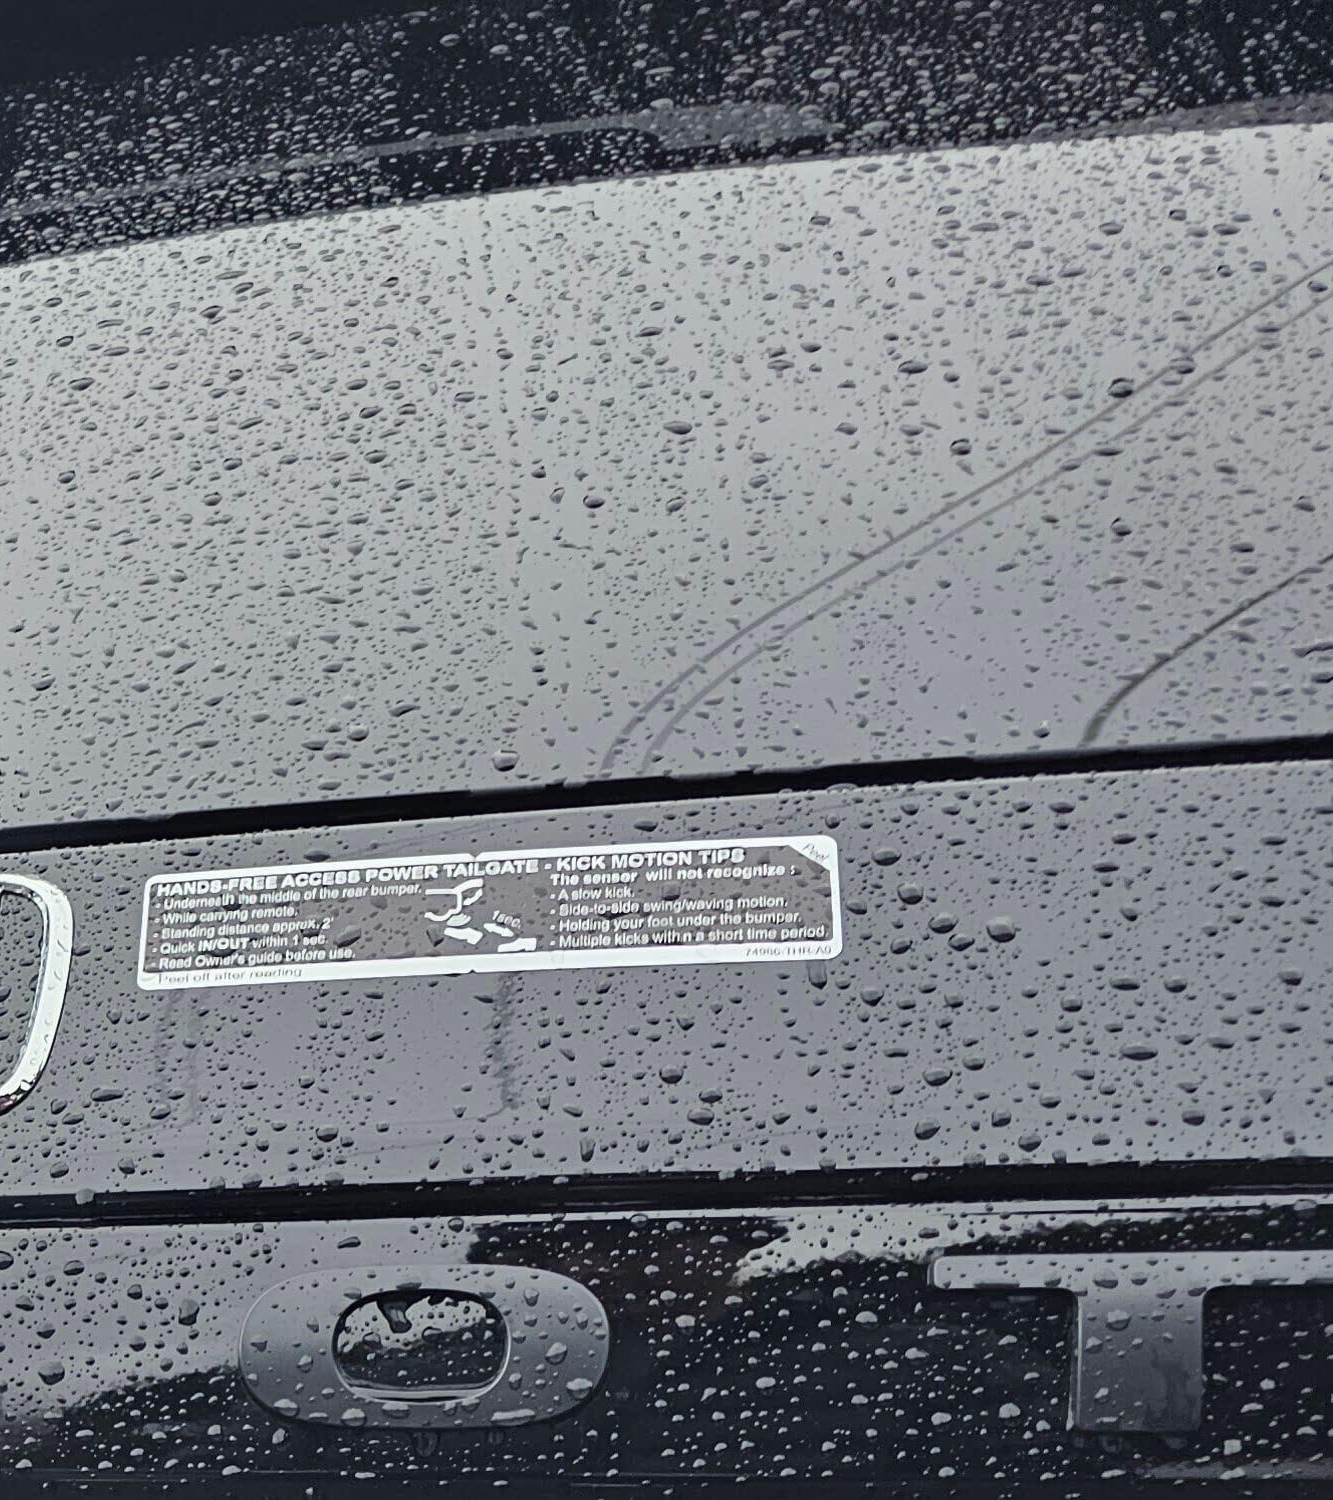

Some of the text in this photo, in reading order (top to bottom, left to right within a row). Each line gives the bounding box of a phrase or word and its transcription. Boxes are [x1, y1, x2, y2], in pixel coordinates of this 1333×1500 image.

[157, 877, 278, 896] HANDS-FREE
[281, 871, 360, 888] ACCESS
[365, 866, 438, 882] POWER
[443, 860, 539, 877] TAILGATE
[556, 856, 606, 871] KICK
[611, 852, 692, 869] MOTION
[698, 848, 745, 865] TIPS
[550, 873, 579, 886] The
[583, 871, 638, 885] sensor
[645, 867, 673, 882] will
[676, 867, 703, 881] not
[706, 863, 786, 880] recognize
[238, 893, 258, 905] the
[260, 890, 302, 904] middle
[304, 888, 317, 901] of
[319, 886, 339, 899] the
[341, 885, 368, 898] rear
[558, 889, 569, 901] A
[571, 887, 602, 900] slow
[643, 899, 733, 914] swing/waving
[163, 910, 198, 924] While
[559, 917, 611, 933] Holding
[613, 917, 645, 933] your
[647, 914, 674, 928] foot
[676, 913, 716, 928] under
[719, 912, 743, 925] the
[161, 924, 216, 940] Standing
[217, 922, 270, 936] distance
[559, 934, 612, 949] Multiple
[614, 932, 650, 946] kicks
[695, 931, 705, 943] a
[708, 928, 744, 943] short
[747, 927, 778, 941] time
[160, 940, 196, 955] Quick
[197, 937, 250, 952] IN/OUT
[248, 950, 283, 967] guide
[285, 947, 326, 961] before
